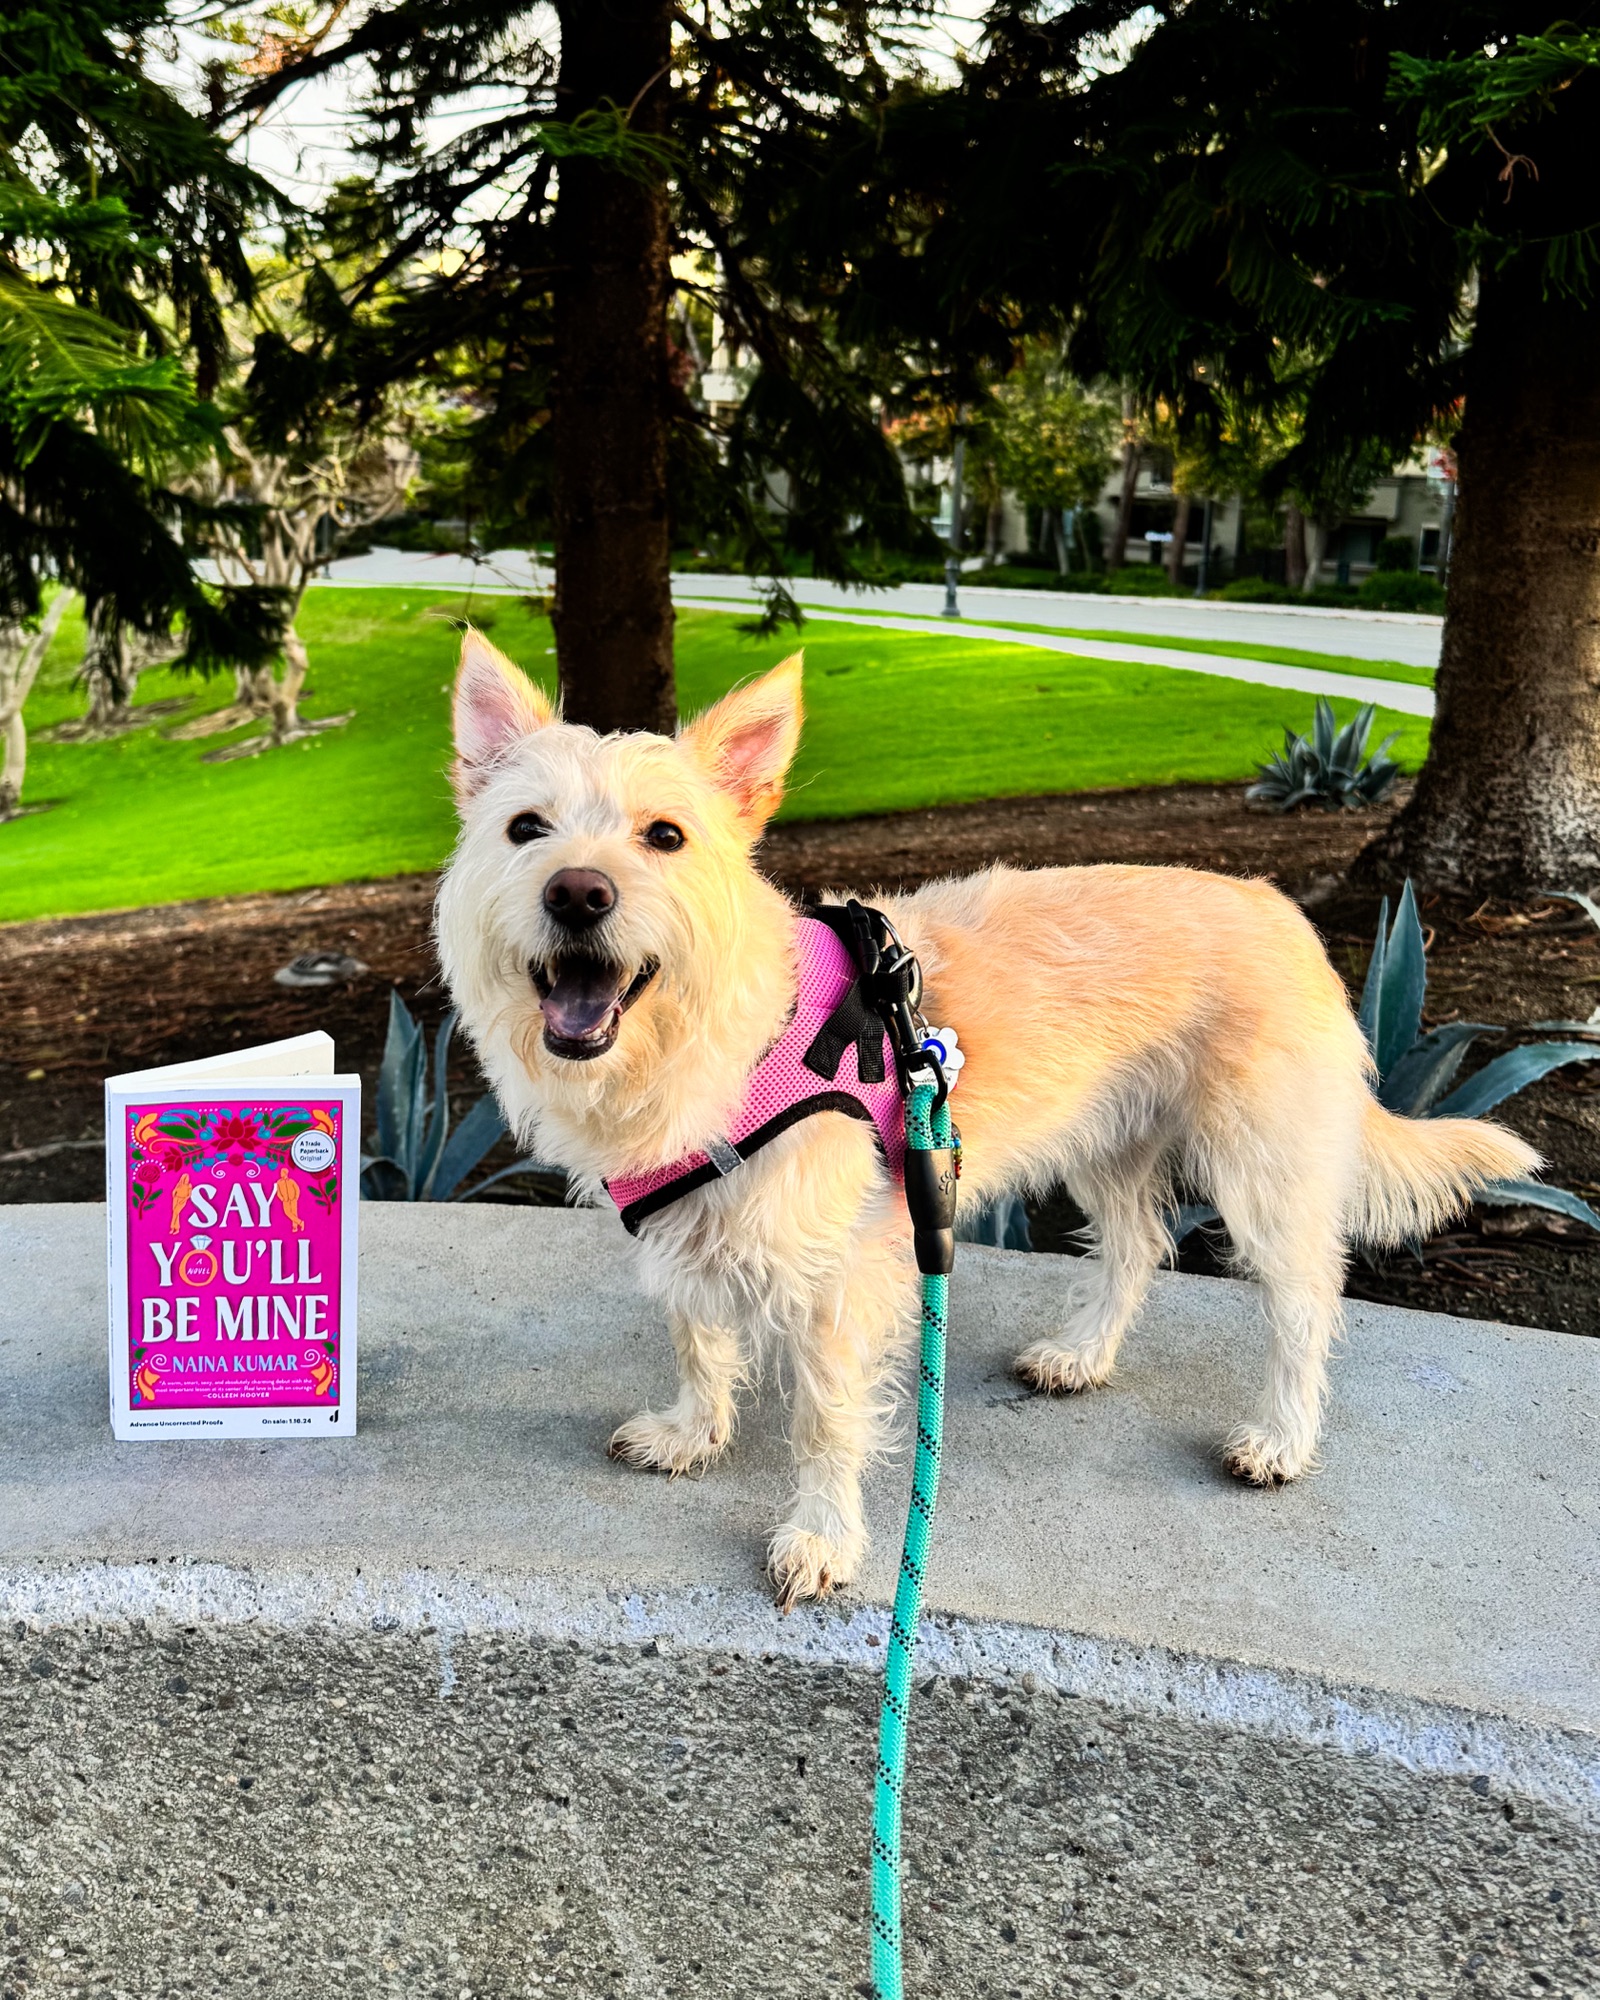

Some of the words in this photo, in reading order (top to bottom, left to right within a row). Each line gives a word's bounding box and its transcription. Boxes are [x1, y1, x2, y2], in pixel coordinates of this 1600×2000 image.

[188, 1182, 278, 1229] SAY
[149, 1234, 322, 1288] YOU'LL
[186, 1267, 211, 1275] NOVEL
[141, 1297, 200, 1344] BE
[215, 1295, 329, 1342] MINE
[172, 1355, 225, 1374] NAINA
[233, 1353, 298, 1372] KUMAR
